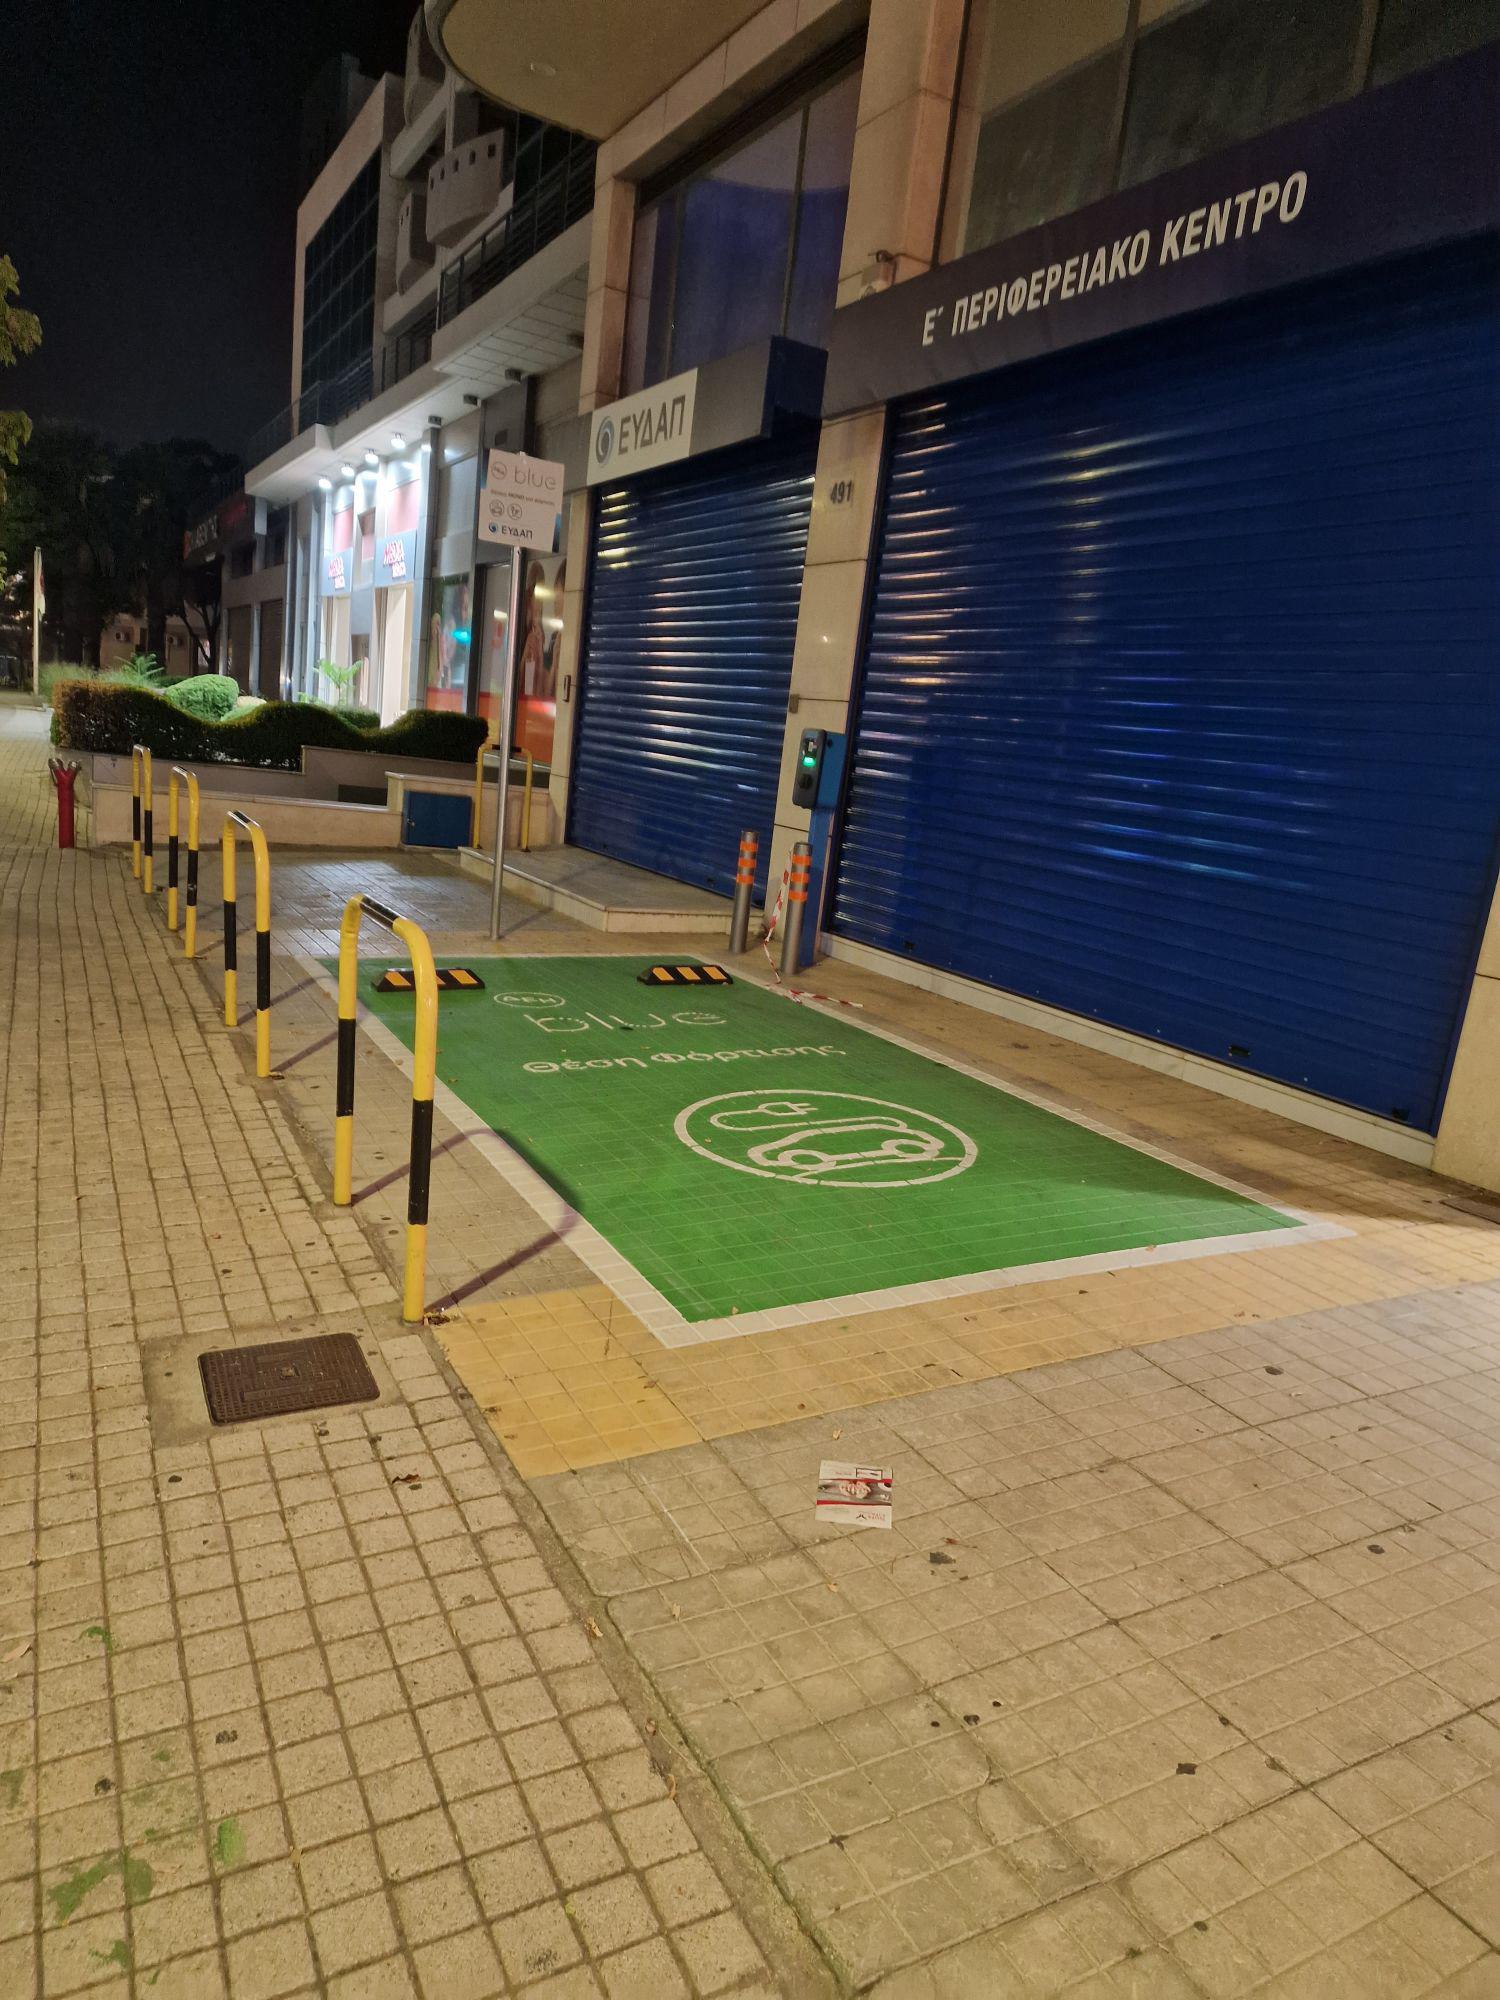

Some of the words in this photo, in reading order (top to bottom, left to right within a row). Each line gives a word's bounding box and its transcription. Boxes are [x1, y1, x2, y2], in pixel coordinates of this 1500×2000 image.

[951, 229, 1150, 337] ΠΕΡΙΦΕΡΕΙΑΚΟ
[1158, 169, 1309, 266] ΚΕΝΤΡΟ
[618, 394, 686, 456] ΕΥΔΑΠ
[514, 465, 557, 491] blue
[501, 525, 533, 540] ΕΥΔΑΠ
[523, 1011, 728, 1033] blue
